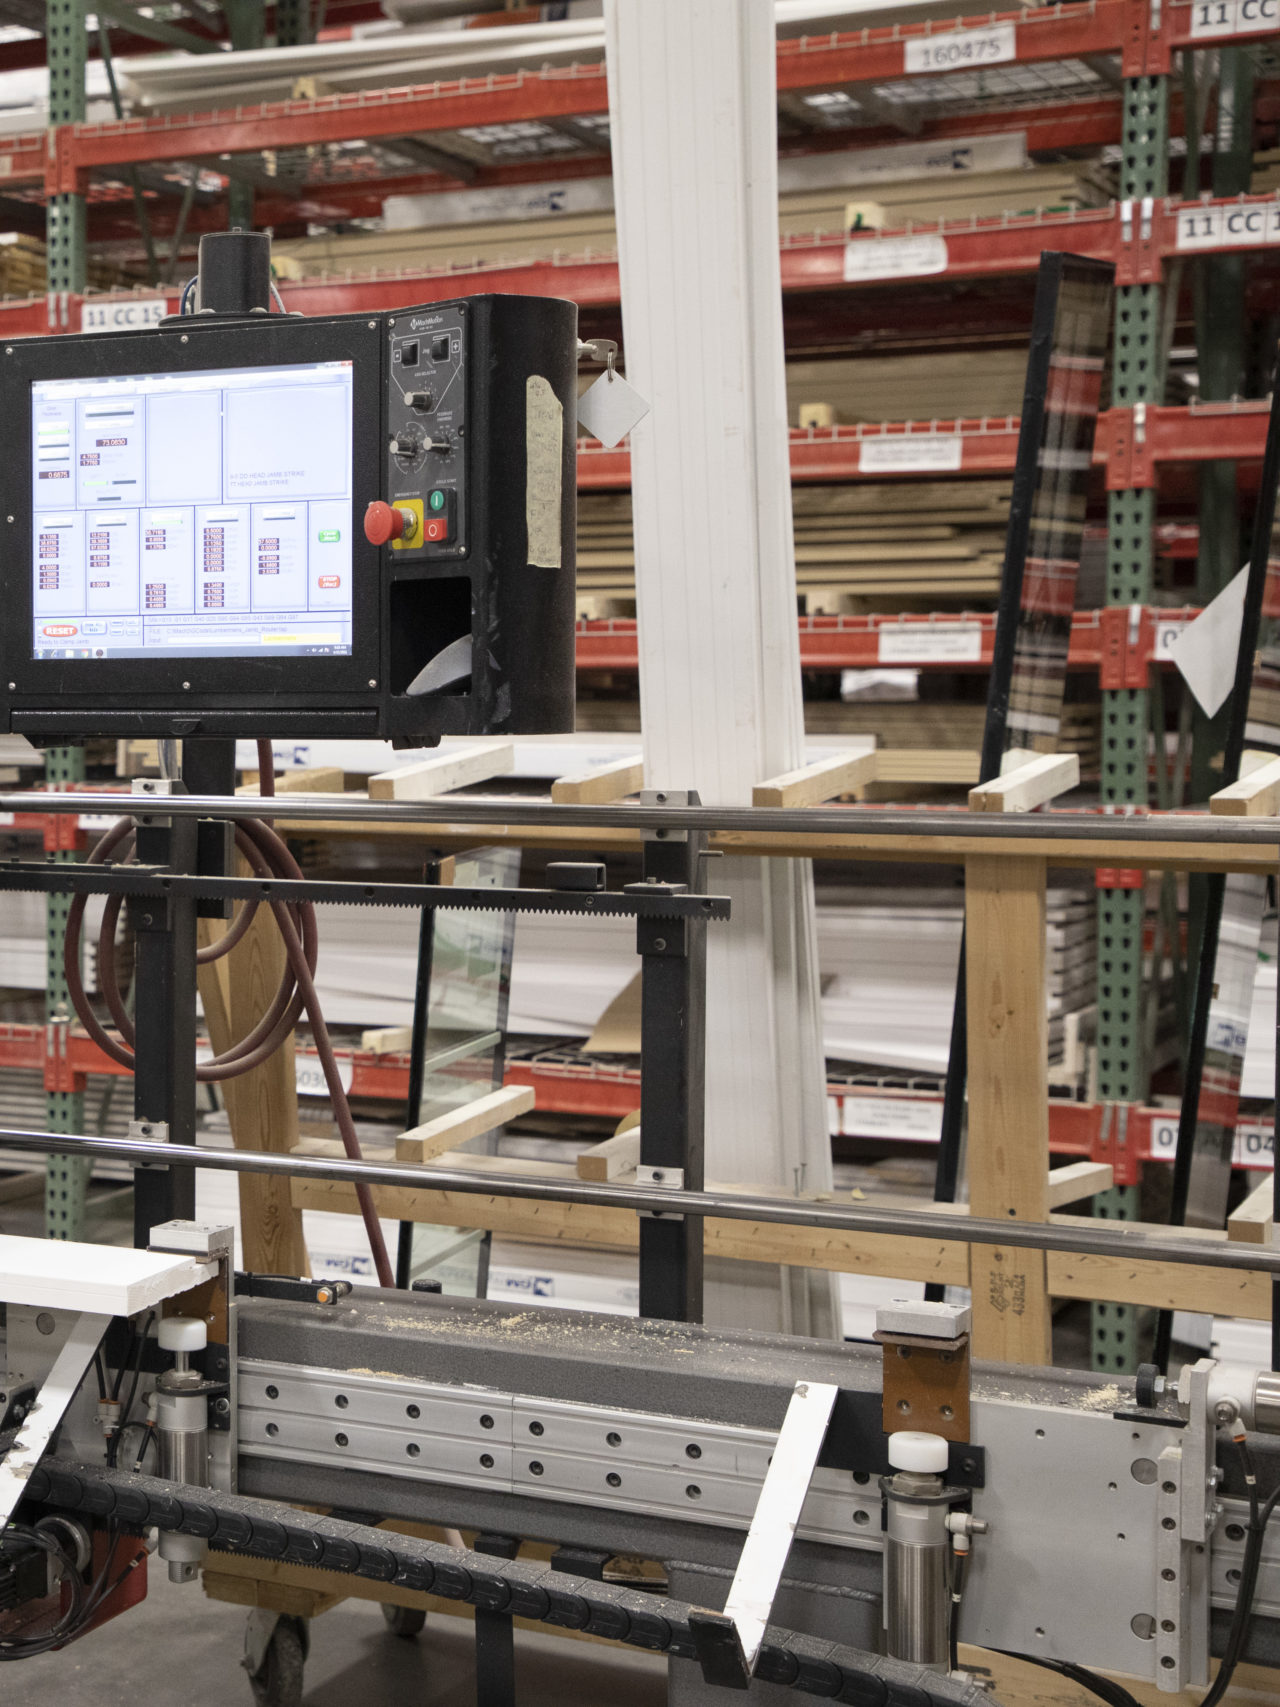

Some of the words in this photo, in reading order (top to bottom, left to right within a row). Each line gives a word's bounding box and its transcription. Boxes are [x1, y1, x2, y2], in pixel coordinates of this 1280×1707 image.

[1199, 3, 1229, 26] 11
[1242, 0, 1276, 20] CC
[922, 37, 1001, 67] 160475
[1185, 216, 1215, 238] 11
[1227, 211, 1262, 233] CC
[88, 310, 106, 326] 11
[114, 308, 135, 326] CC
[143, 305, 163, 323] 15
[45, 627, 74, 635] RESET
[1158, 1127, 1179, 1146] 0
